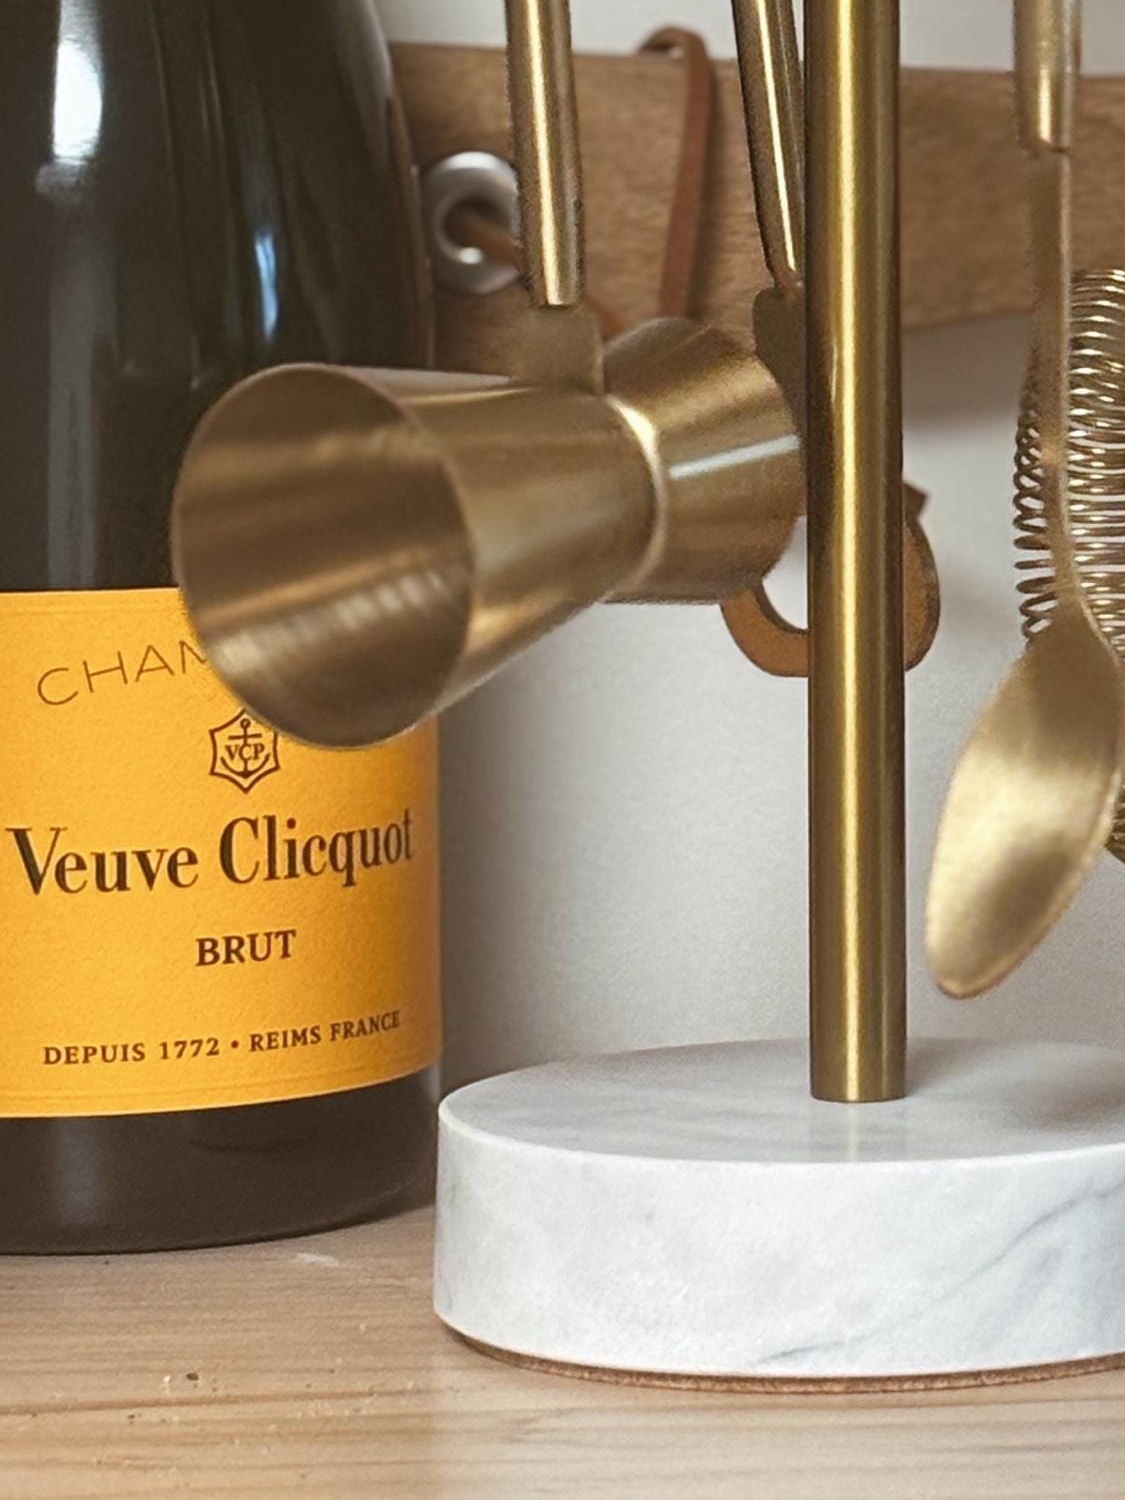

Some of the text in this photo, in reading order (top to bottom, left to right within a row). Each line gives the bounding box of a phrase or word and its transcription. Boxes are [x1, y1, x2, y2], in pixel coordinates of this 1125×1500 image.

[225, 743, 265, 761] VCP
[6, 807, 413, 896] Veuve Clicquot
[195, 929, 297, 966] BRUT
[43, 1010, 401, 1066] DEPUIS 1772 REIMS FRANCE
